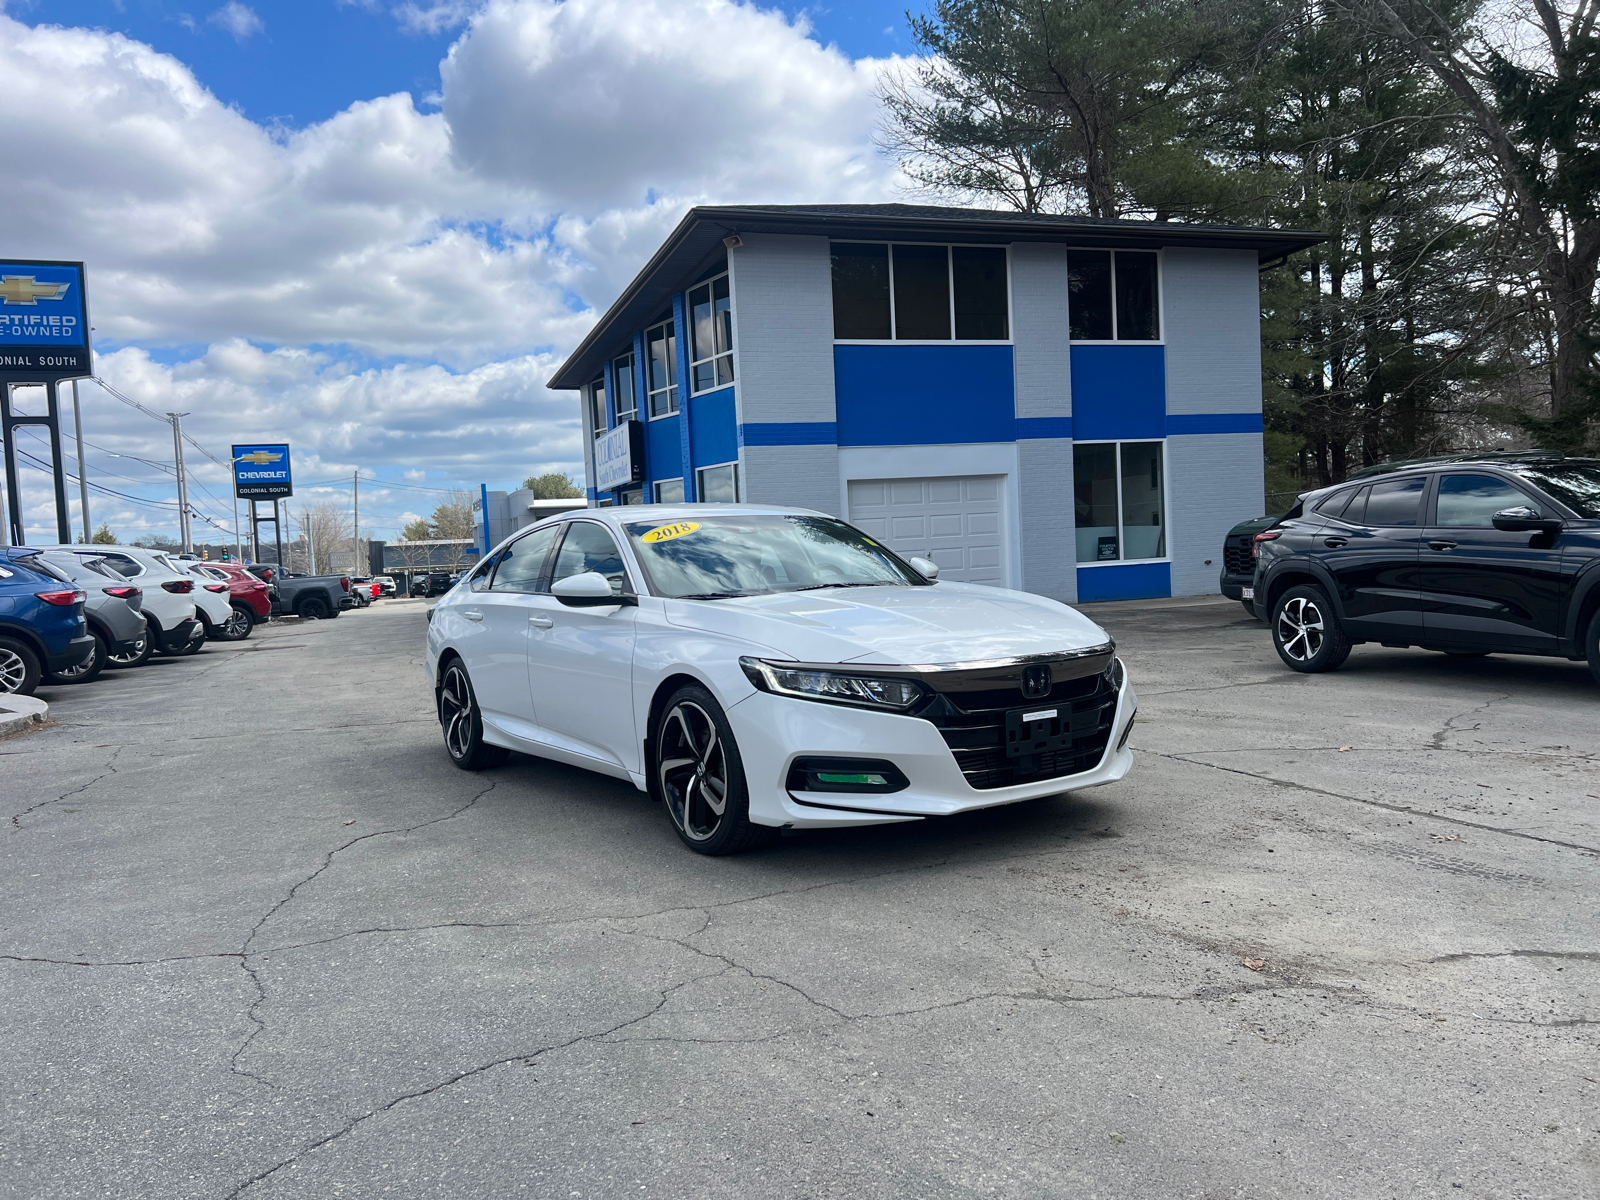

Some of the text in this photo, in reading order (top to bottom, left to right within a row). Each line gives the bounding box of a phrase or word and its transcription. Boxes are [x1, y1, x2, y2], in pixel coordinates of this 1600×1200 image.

[0, 315, 77, 326] RTIFIED
[39, 356, 77, 366] SOUTH
[598, 430, 627, 467] COLONIAL
[239, 471, 287, 479] CHEVROLET
[653, 523, 691, 540] 2018
